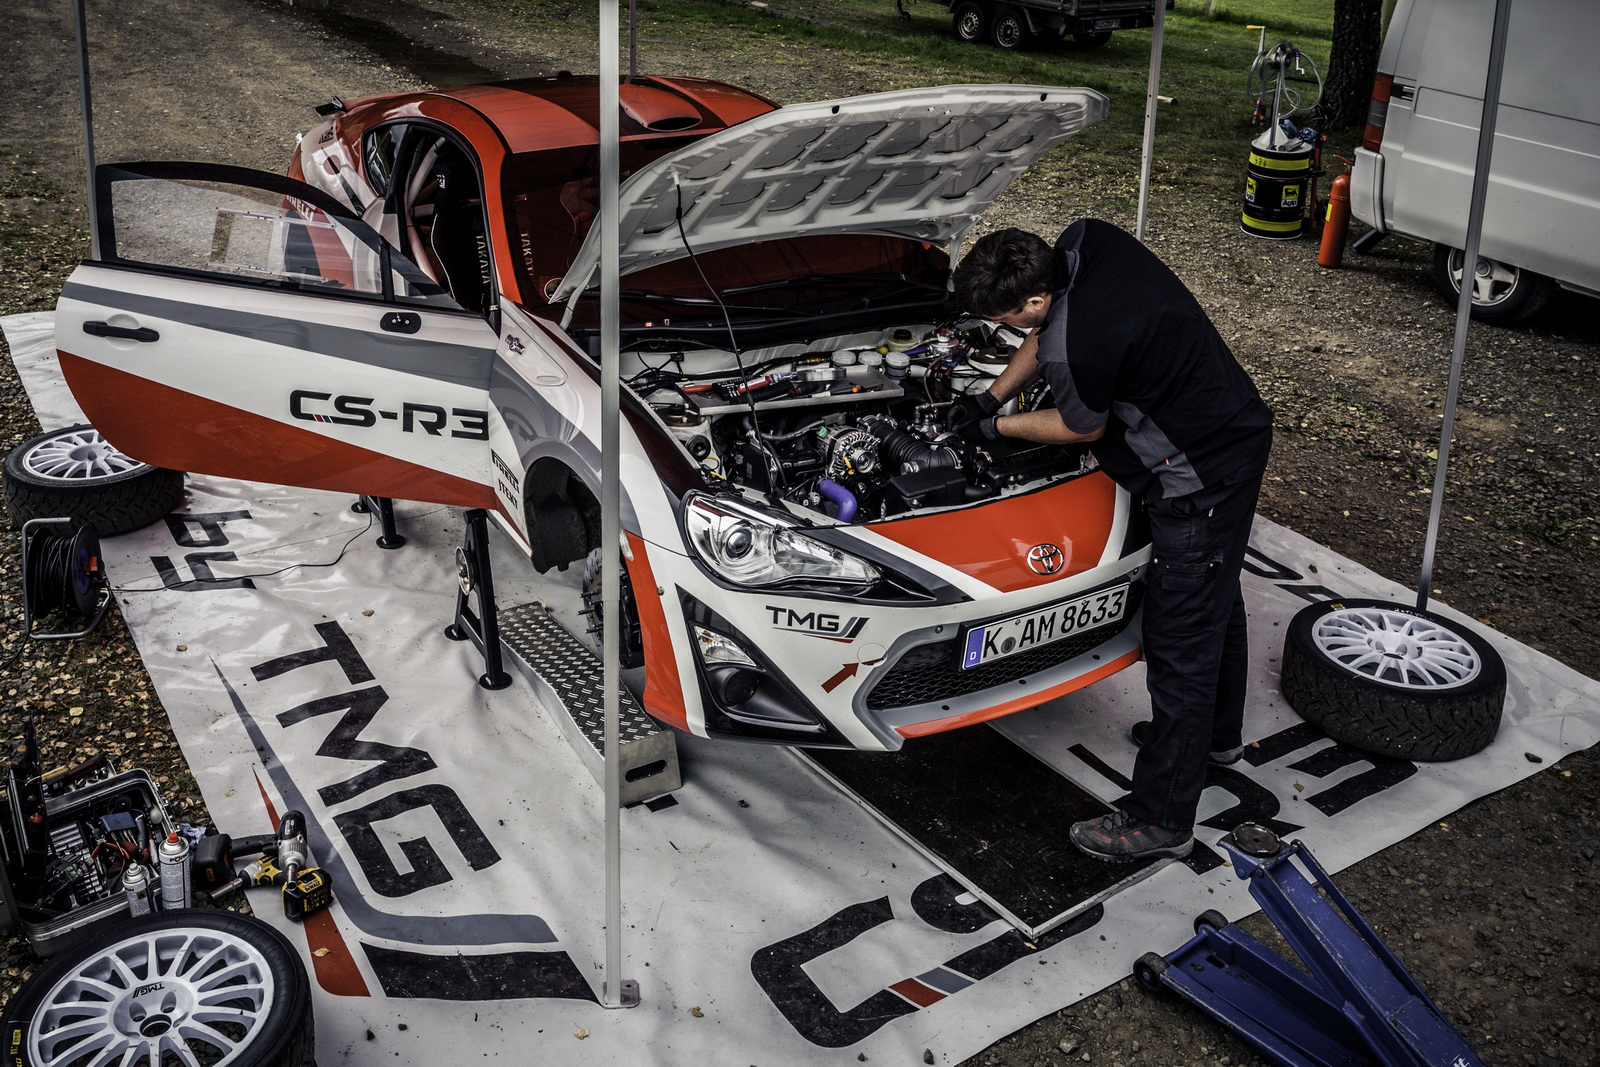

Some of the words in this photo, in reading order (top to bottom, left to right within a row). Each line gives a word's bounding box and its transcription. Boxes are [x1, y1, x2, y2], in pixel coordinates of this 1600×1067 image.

[1282, 199, 1297, 208] Agip
[476, 234, 491, 285] TAKATA
[289, 389, 490, 441] CS-R3
[491, 448, 520, 494] PIRELLI
[765, 605, 840, 633] TMG
[982, 627, 1003, 659] K
[1018, 611, 1057, 648] AM
[1060, 589, 1125, 634] 8633
[969, 651, 978, 661] D
[250, 620, 502, 898] TMG
[140, 983, 165, 996] TMG
